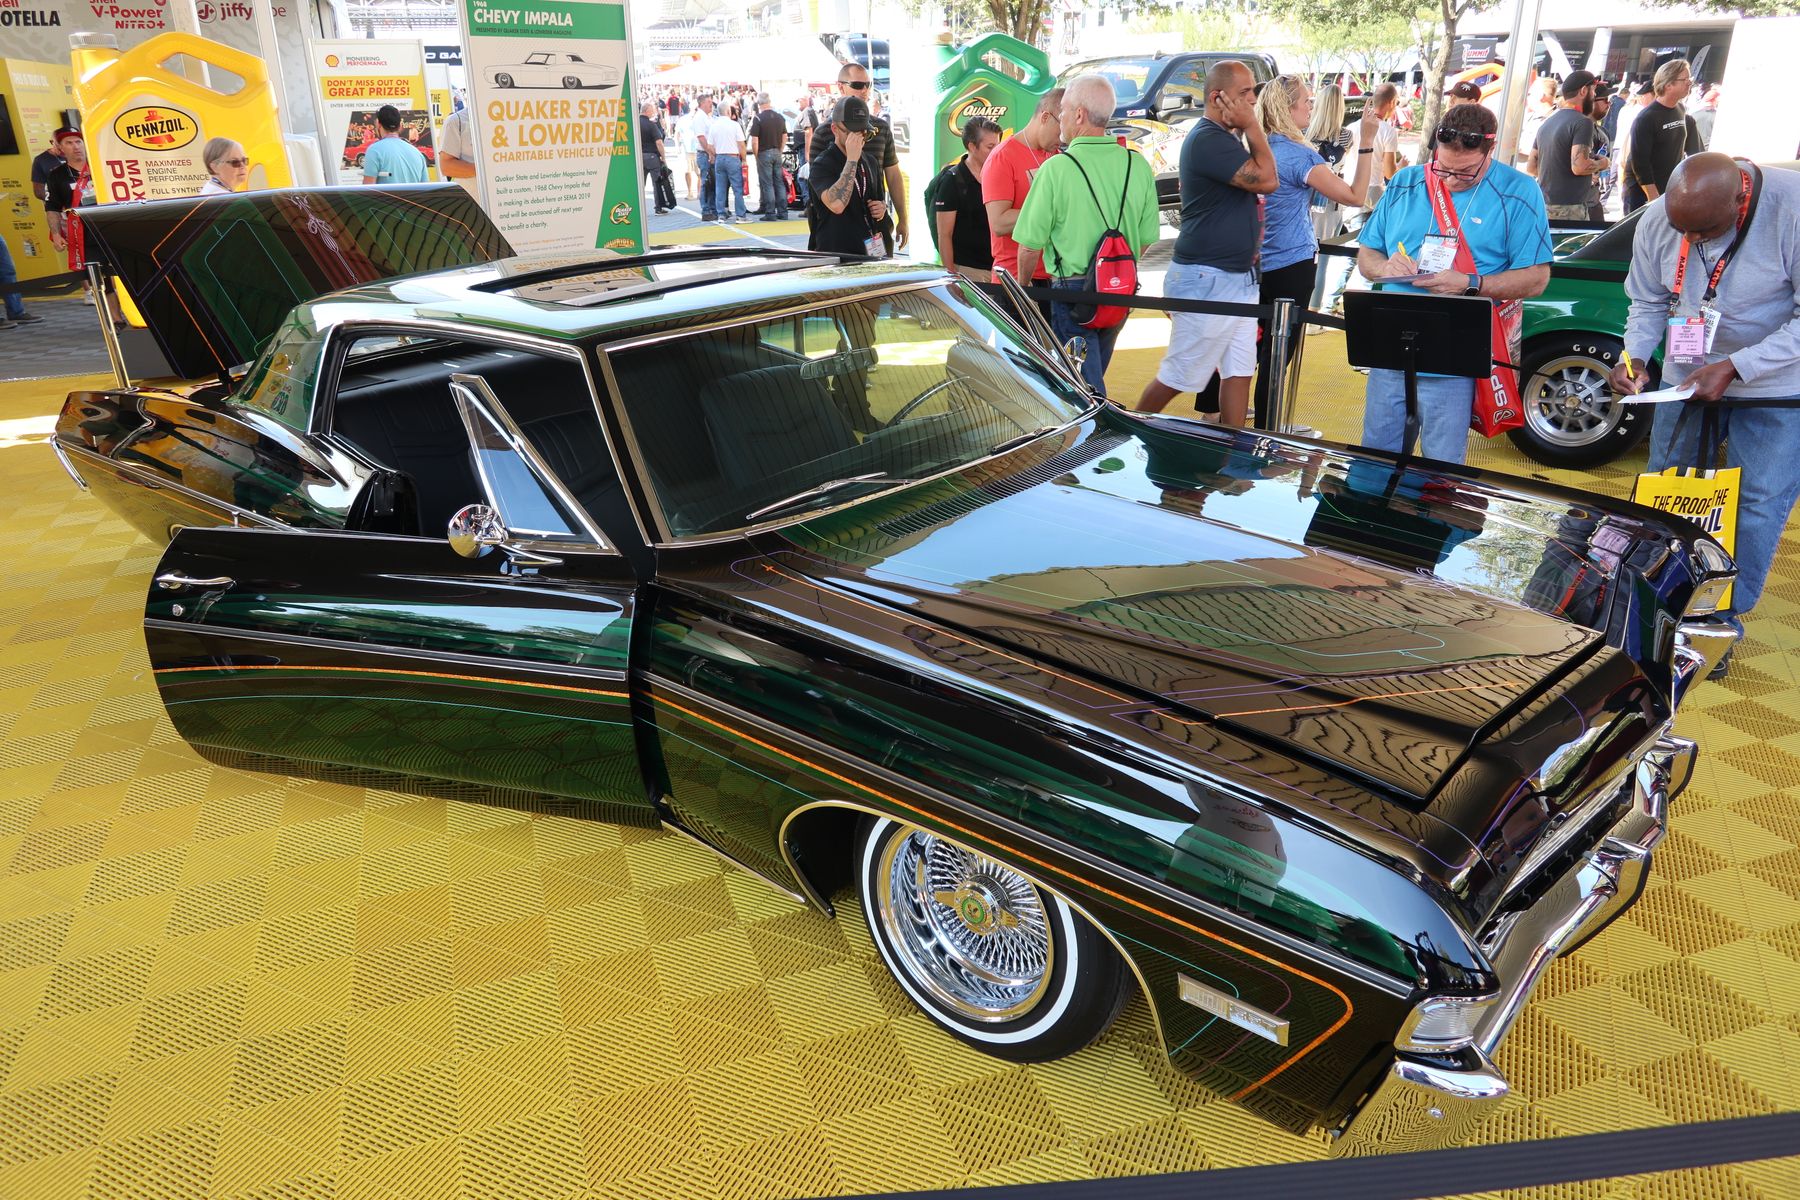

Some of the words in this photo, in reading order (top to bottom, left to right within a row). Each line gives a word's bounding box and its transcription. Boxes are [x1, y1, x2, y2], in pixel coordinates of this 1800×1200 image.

[472, 0, 487, 8] 1968
[0, 11, 61, 26] OTELLA
[91, 5, 163, 18] V-Power
[220, 3, 253, 20] jiffy
[473, 8, 521, 24] CHEVY
[525, 11, 573, 27] IMPALA
[328, 87, 365, 97] GREAT
[369, 87, 410, 96] PRIZES!
[487, 99, 571, 121] QUAKER
[578, 98, 626, 119] STATE
[963, 105, 1007, 116] QUAKER
[126, 118, 185, 139] PENNZOIL
[491, 125, 510, 148] &
[518, 121, 628, 147] LOWRIDER
[492, 149, 554, 163] CHARITABLE
[556, 147, 594, 159] VEHICLE
[597, 145, 630, 156] UNVEIL
[145, 160, 192, 168] MAXIMIZES
[149, 174, 210, 182] PERFORMANCE
[495, 175, 514, 183] Quaker
[540, 171, 561, 179] Lowrider
[562, 170, 585, 178] Magazine
[548, 183, 563, 191] Chevy
[564, 182, 580, 190] Impala
[528, 208, 553, 217] auctioned
[572, 206, 583, 214] year
[1437, 190, 1452, 228] SPYDER
[507, 223, 524, 231] benefit
[1676, 256, 1686, 286] MAXXIS
[1652, 495, 1672, 512] THE
[1671, 495, 1712, 515] PROOF
[1713, 488, 1729, 506] THE
